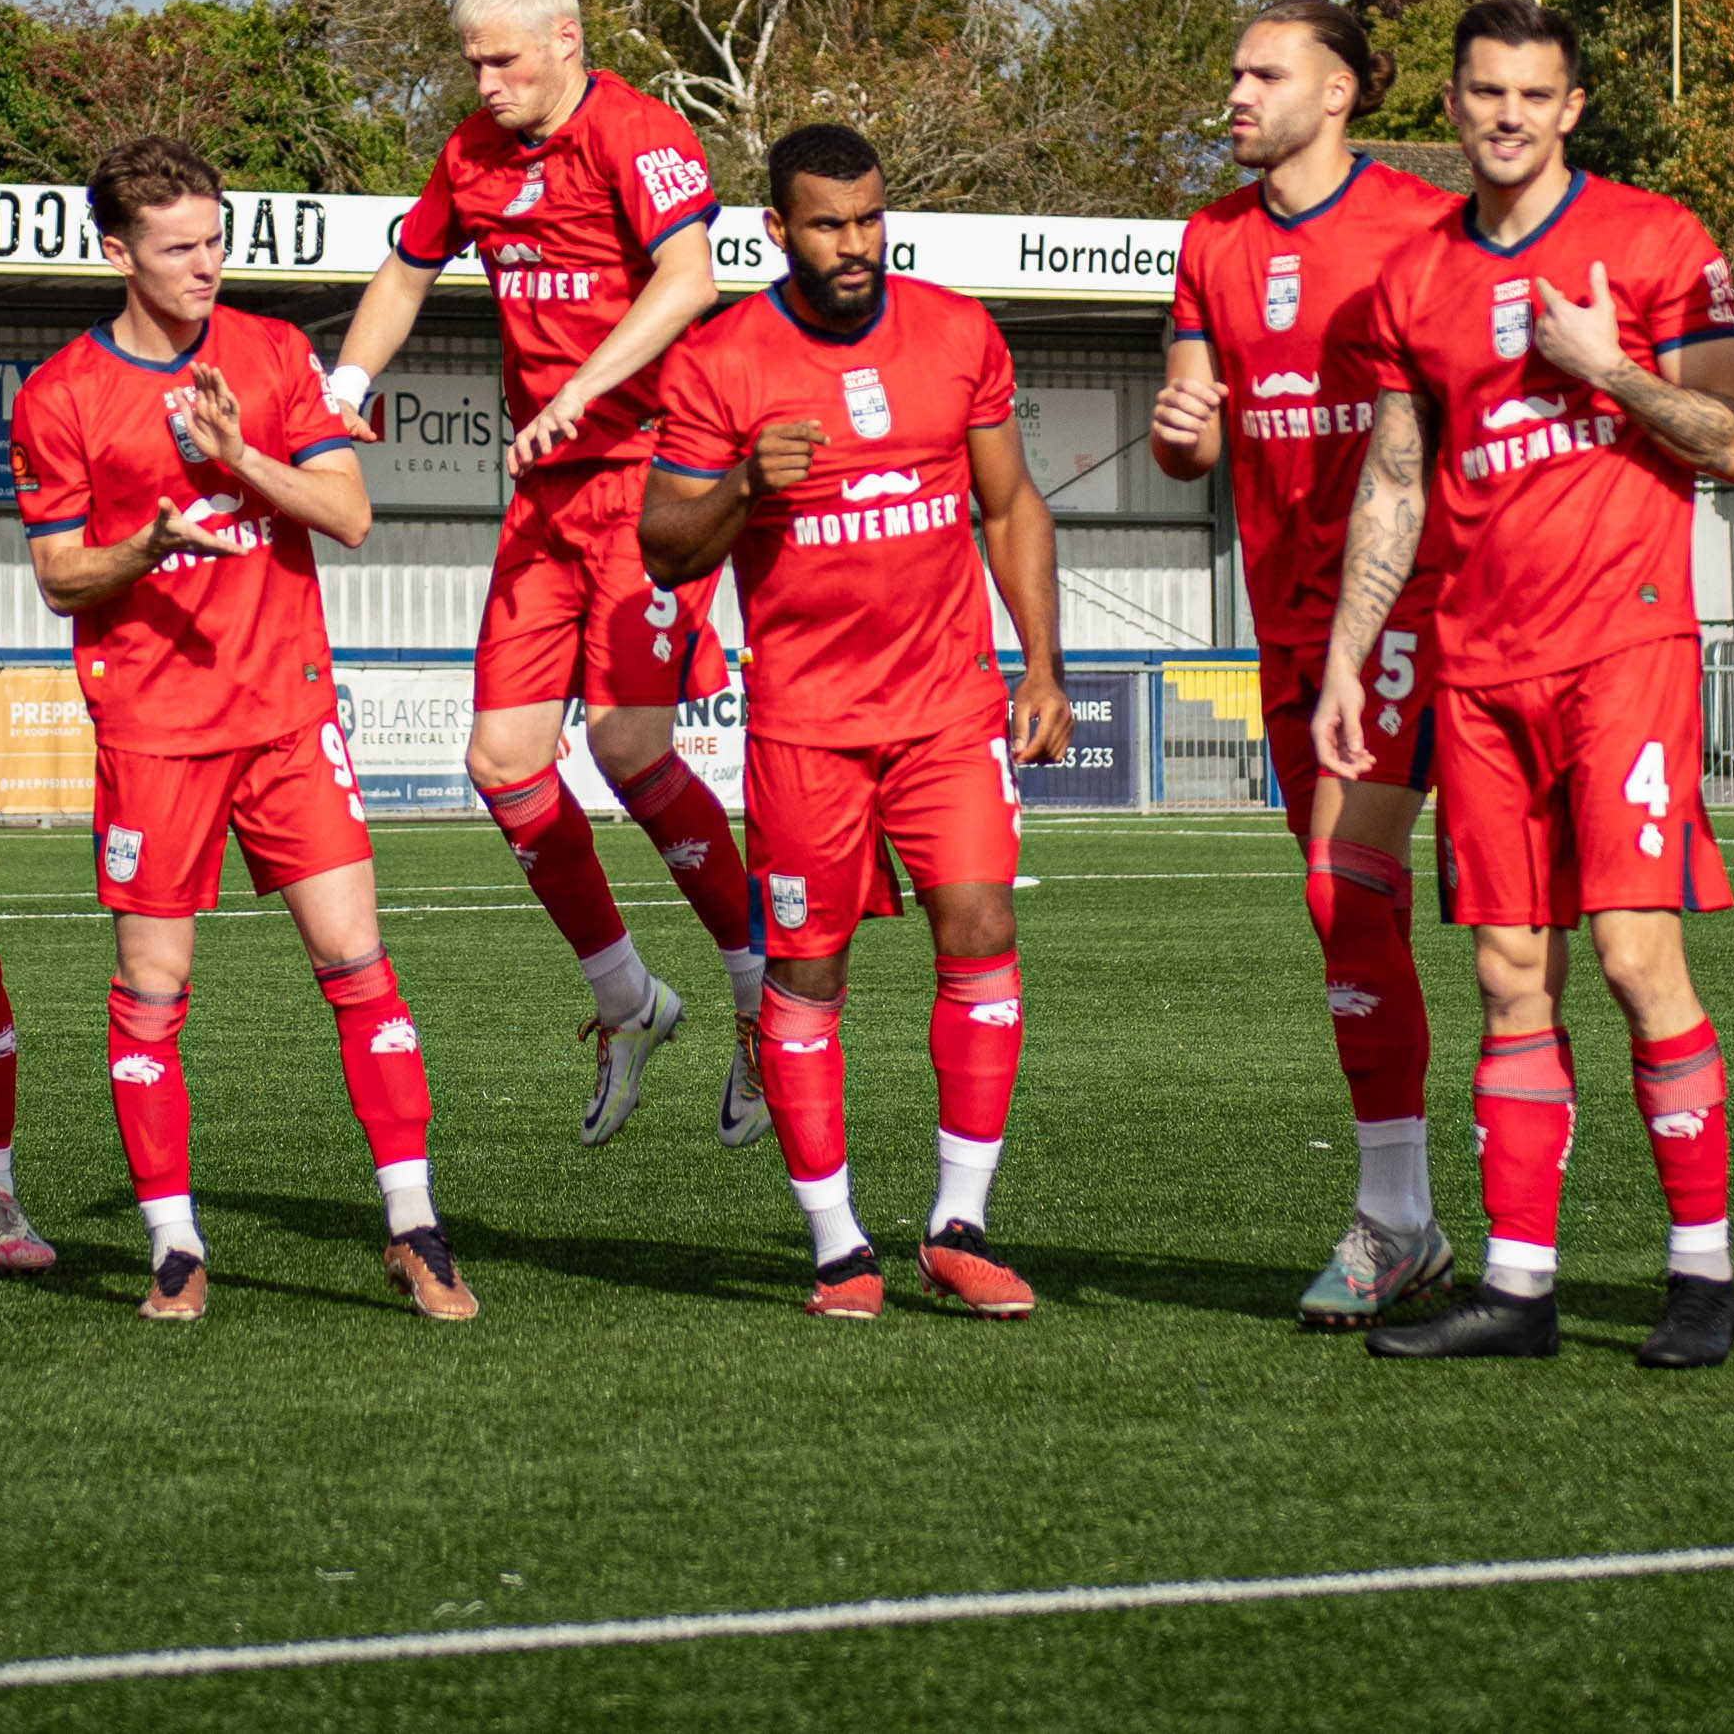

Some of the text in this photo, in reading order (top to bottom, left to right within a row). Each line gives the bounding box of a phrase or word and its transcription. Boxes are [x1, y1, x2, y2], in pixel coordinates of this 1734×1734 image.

[635, 147, 684, 176] QUA
[644, 160, 704, 195] RTER
[652, 175, 708, 213] BACK
[220, 197, 326, 266] AD
[1019, 233, 1176, 277] Horndea
[395, 392, 491, 446] Paris
[394, 459, 462, 472] LEGAL
[1461, 416, 1616, 482] MOVEMBER
[794, 494, 957, 546] MOVEMBER
[1373, 629, 1418, 701] 5
[10, 701, 94, 726] PREPPE
[361, 698, 474, 729] BLAKERS
[320, 722, 354, 788] 9
[361, 732, 467, 745] ELECTRICAL LT
[1079, 747, 1114, 768] 233
[0, 777, 95, 792] @PREPPEDBYKO
[1623, 741, 1669, 817] 4
